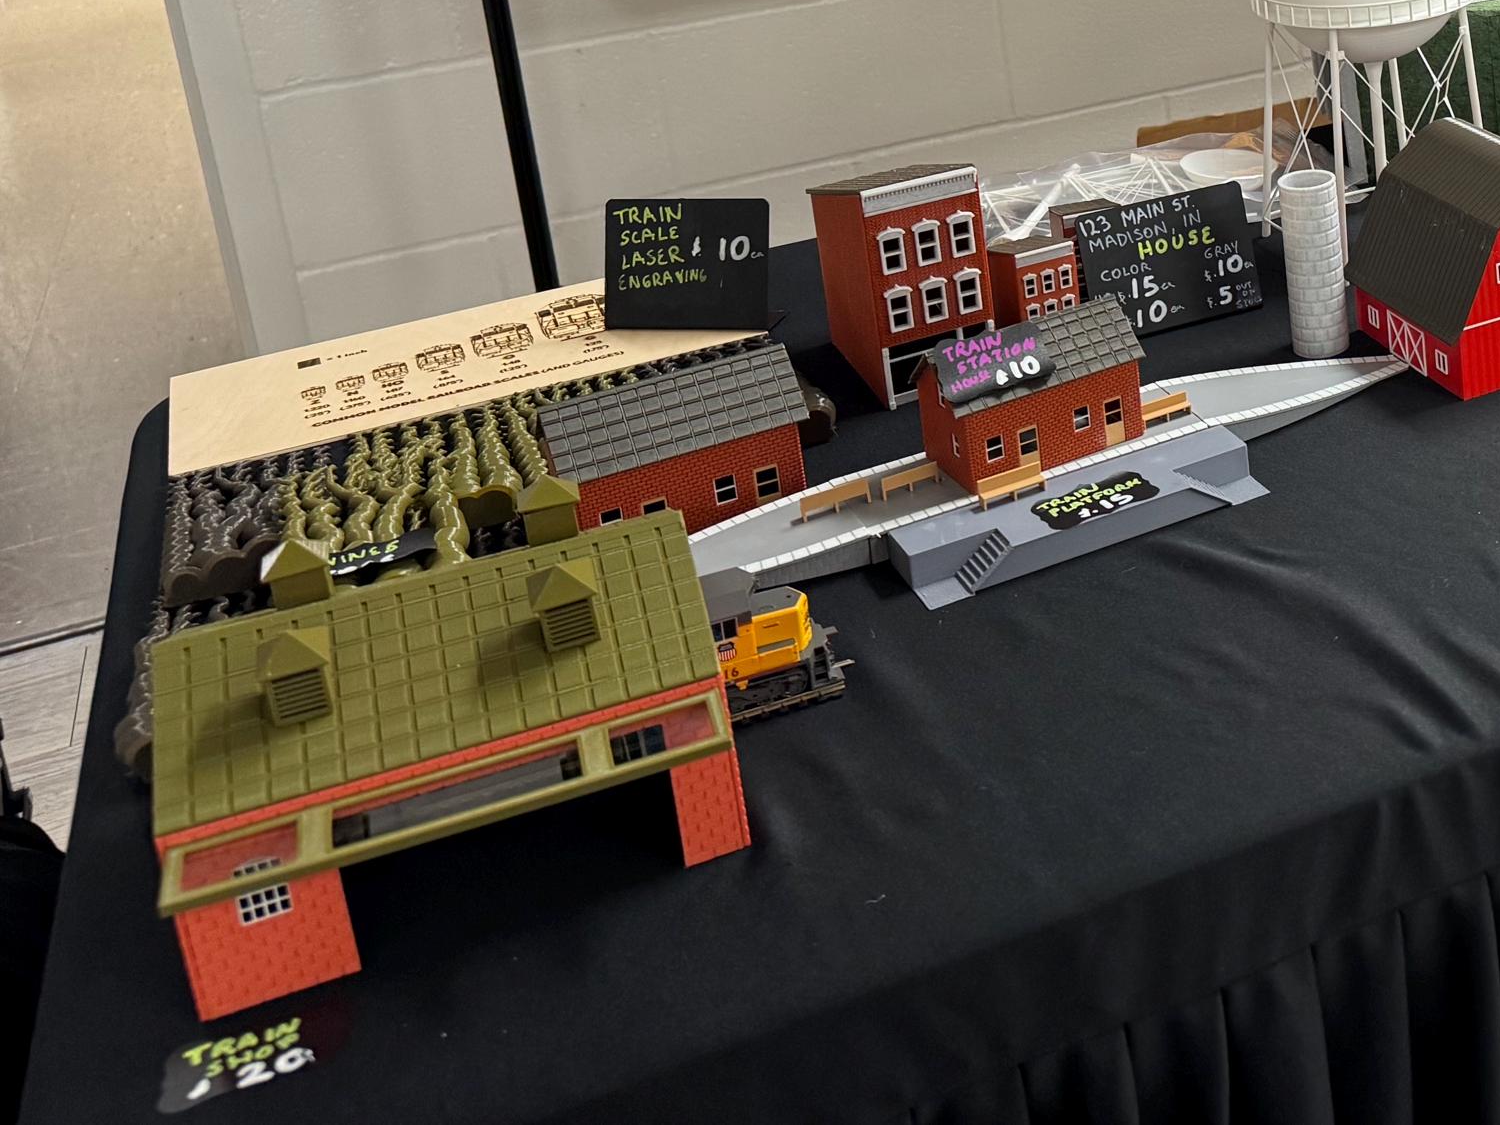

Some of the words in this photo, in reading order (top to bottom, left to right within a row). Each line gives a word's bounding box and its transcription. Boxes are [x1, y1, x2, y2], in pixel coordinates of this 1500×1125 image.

[612, 203, 683, 225] TRAIN
[1079, 215, 1112, 237] 123
[1120, 200, 1165, 228] MAIN
[1173, 194, 1196, 212] ST.
[1182, 208, 1201, 227] IN
[620, 225, 680, 246] SCALE
[1137, 225, 1216, 261] HOUSE
[1204, 239, 1240, 259] GRAY
[621, 244, 686, 270] LASER
[718, 235, 751, 262] 10
[1217, 253, 1244, 277] 10
[618, 268, 708, 291] ENGRAVING
[1100, 261, 1152, 282] COLOR
[1131, 274, 1161, 300] 15
[1218, 284, 1234, 306] 5
[1135, 298, 1169, 329] 10
[942, 331, 1002, 363] TRAIN
[956, 336, 1037, 375] STATION
[312, 408, 377, 428] COMMON
[379, 397, 426, 412] MODEL
[427, 380, 492, 401] RAILROAD
[493, 369, 541, 385] SCALES
[541, 362, 570, 374] (AND
[571, 350, 625, 366] GAUGES)
[950, 369, 992, 394] HOUSE
[1036, 482, 1100, 510] TRAIN
[1048, 477, 1143, 517] PLATFORM
[182, 1017, 302, 1066] TRAIN
[205, 1032, 300, 1078] SHOP
